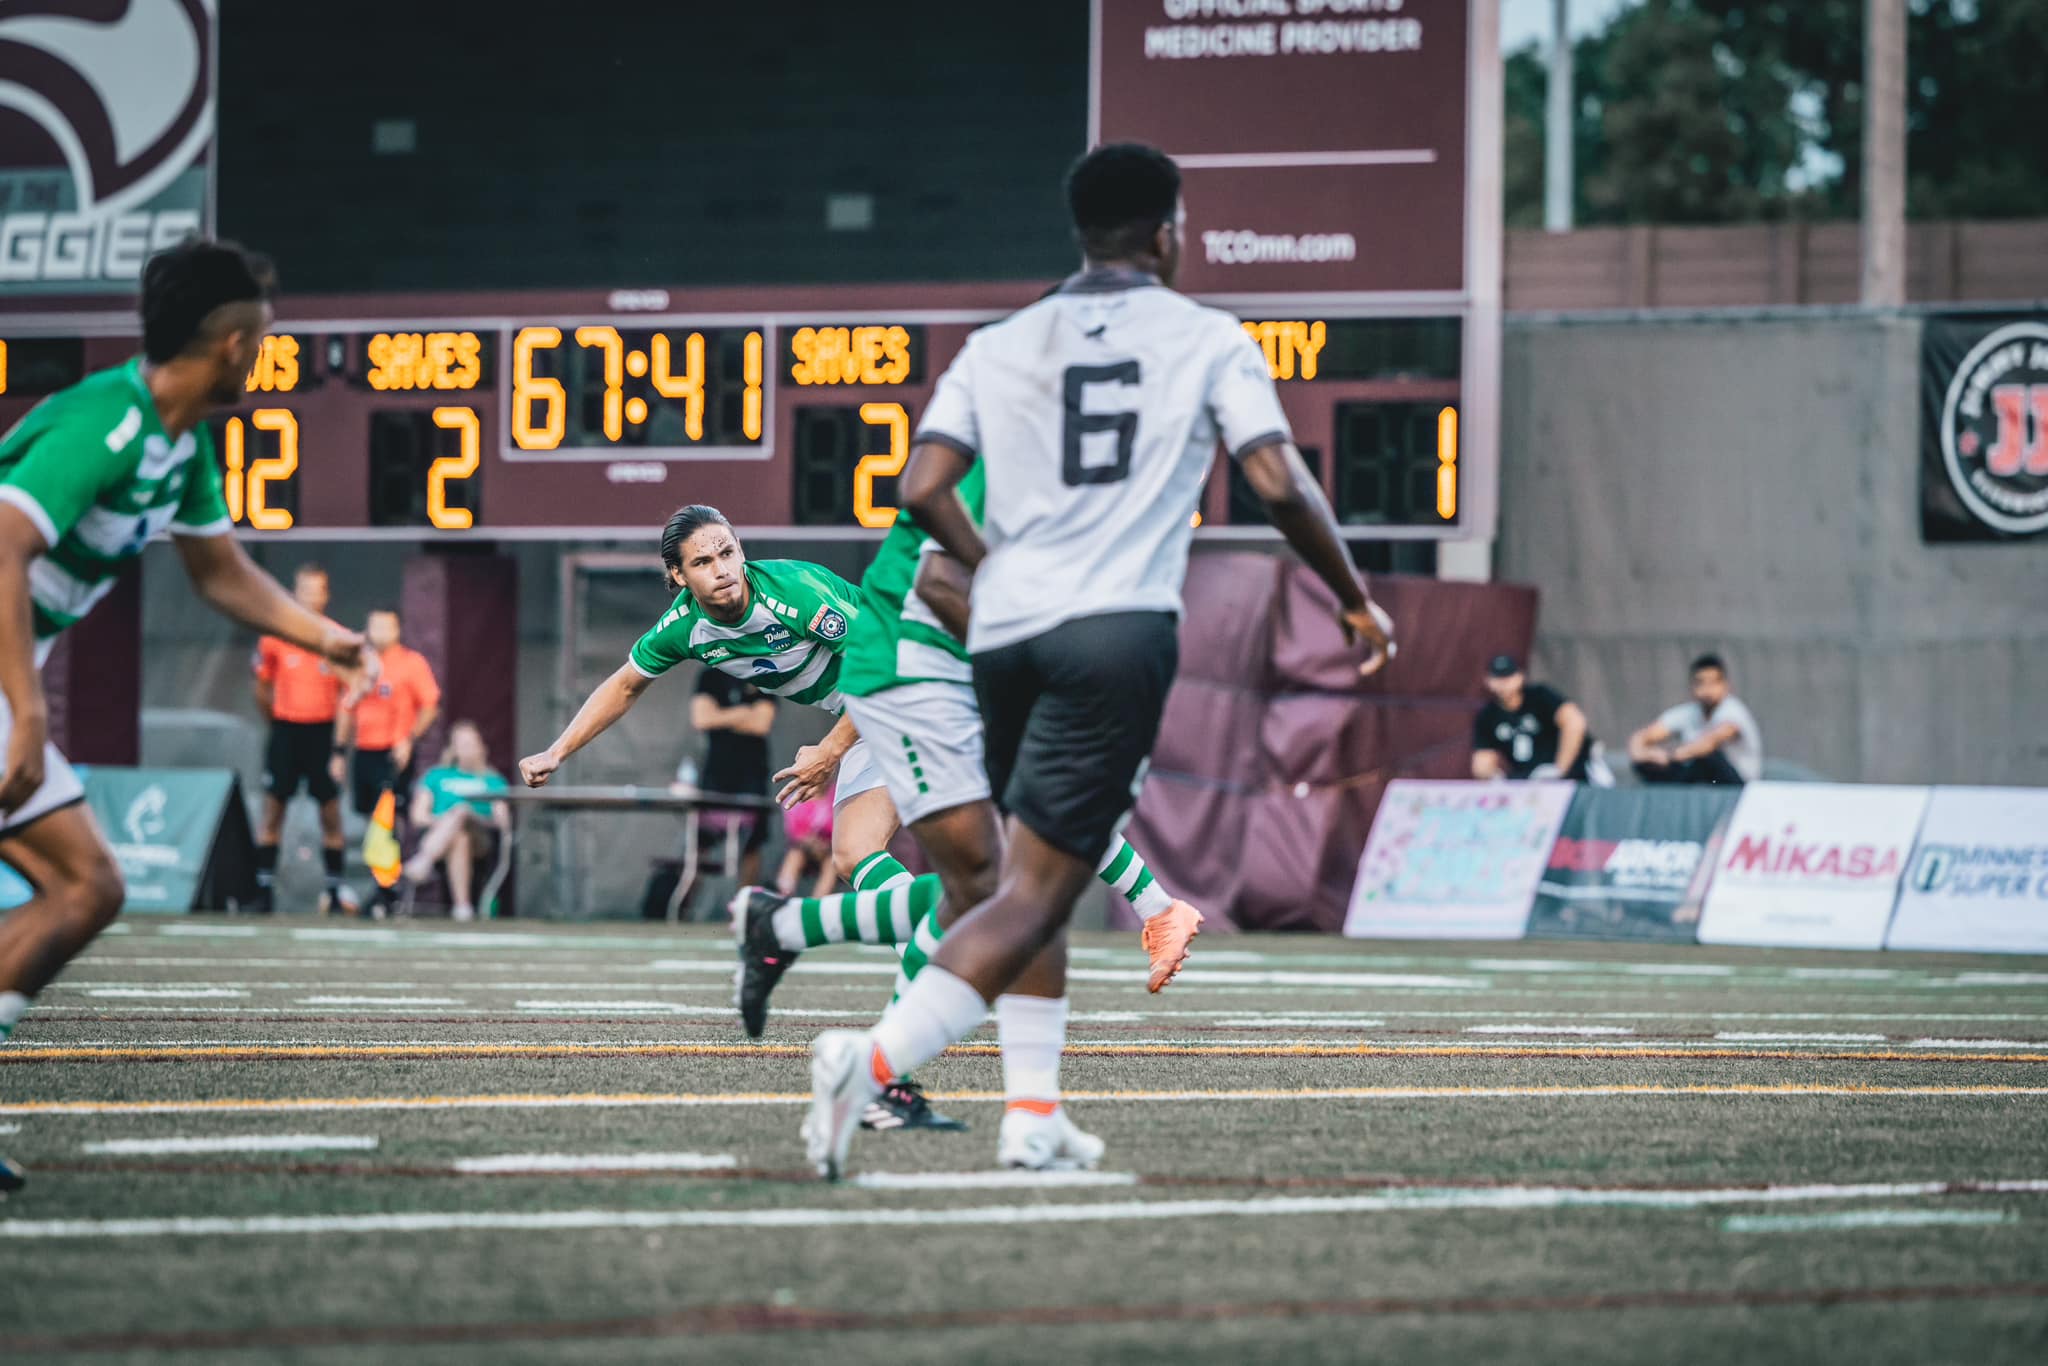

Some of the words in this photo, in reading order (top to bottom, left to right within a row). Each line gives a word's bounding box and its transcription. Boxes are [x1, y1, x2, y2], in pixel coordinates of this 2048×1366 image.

[1144, 23, 1278, 59] MEDICINE
[1280, 17, 1423, 54] PROVIDER
[367, 332, 481, 390] SAVES
[511, 326, 763, 450] 67:41
[791, 326, 910, 385] SAVES
[225, 408, 298, 530] 12
[426, 406, 480, 529] 2
[853, 402, 909, 528] 2
[1062, 359, 1140, 486] 6
[1437, 406, 1457, 519] 1
